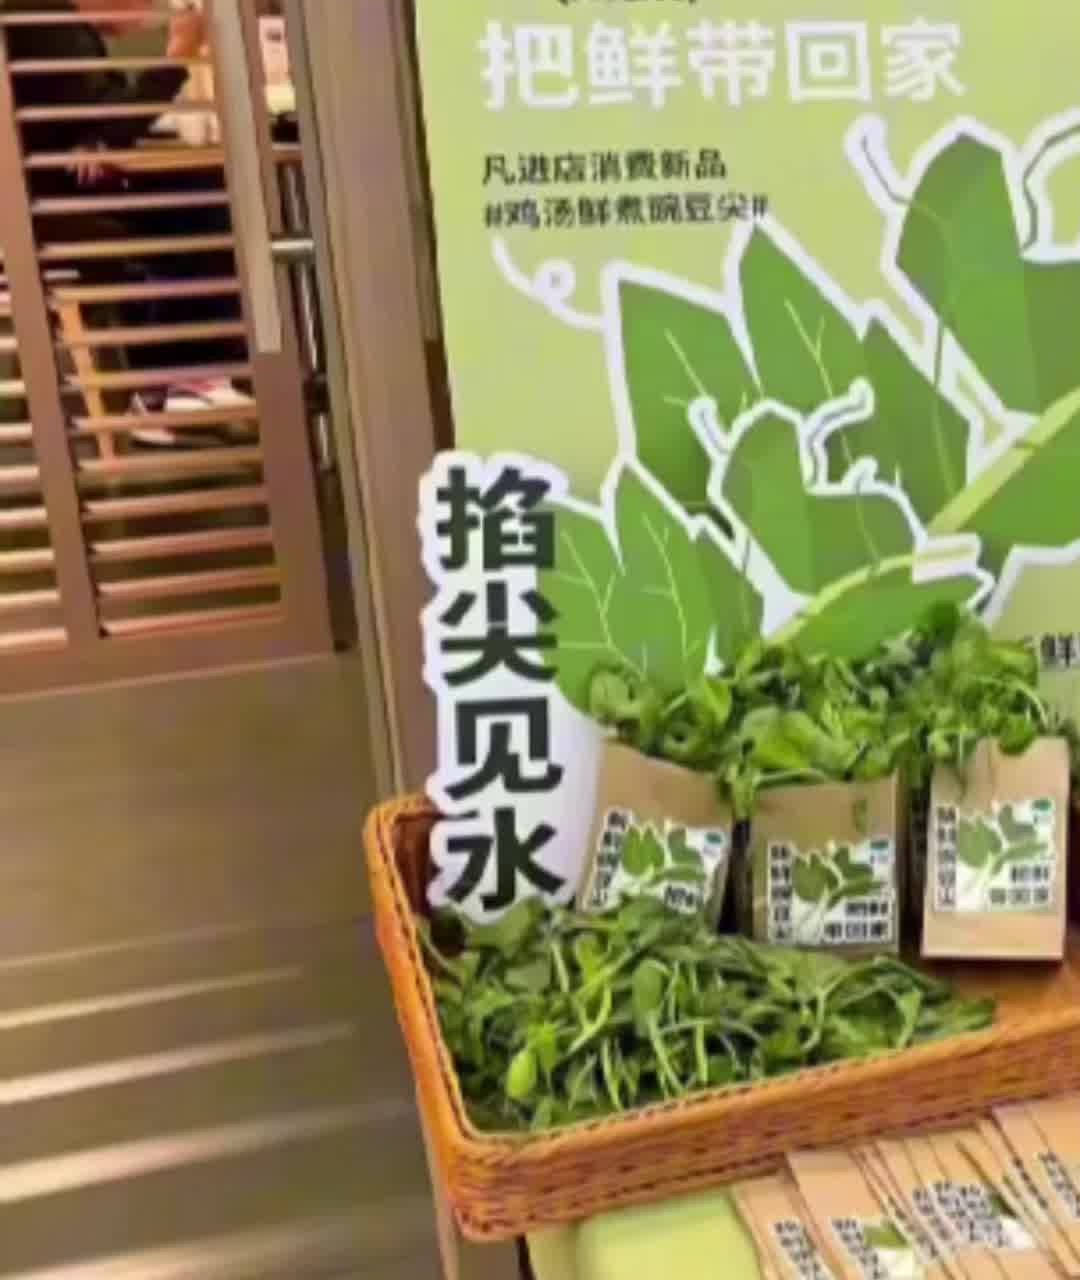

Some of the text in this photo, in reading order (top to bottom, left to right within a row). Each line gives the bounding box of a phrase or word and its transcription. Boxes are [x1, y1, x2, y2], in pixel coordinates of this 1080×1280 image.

[478, 18, 966, 111] 把鲜带回家
[482, 148, 727, 185] 凡进店消费新品
[436, 466, 566, 910] 掐尖见水
